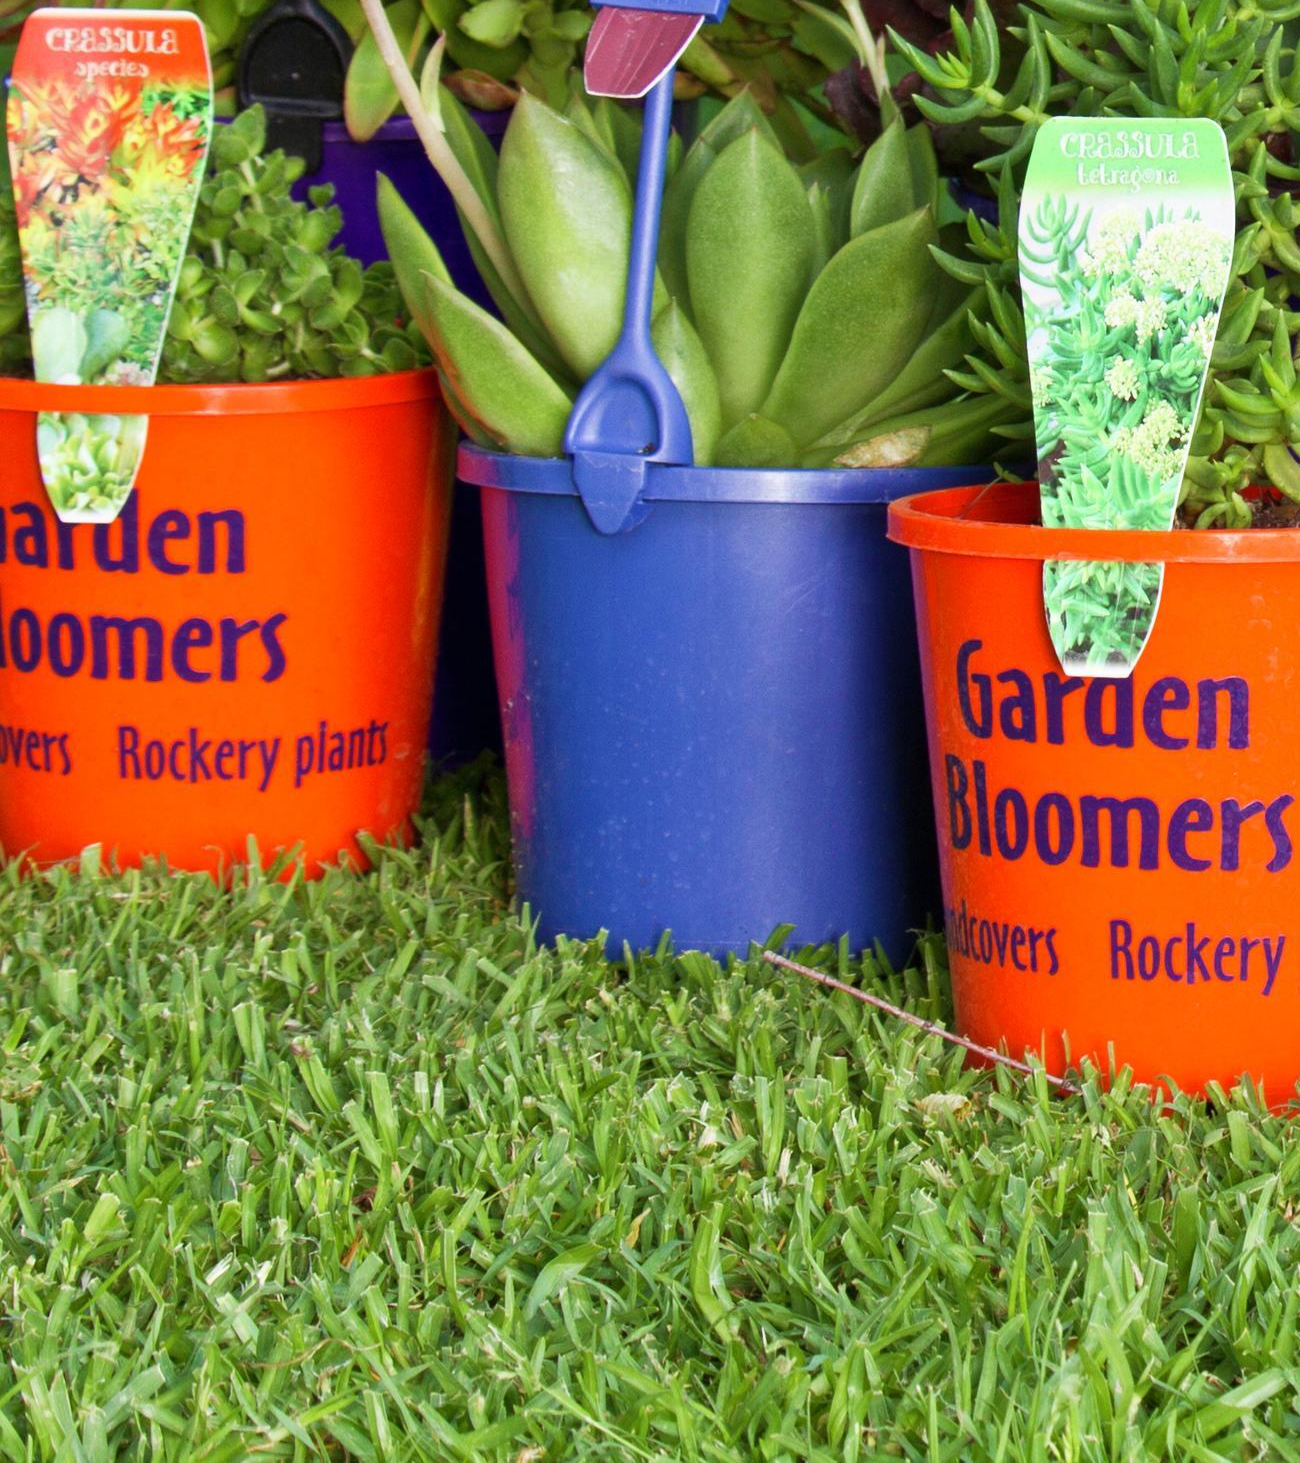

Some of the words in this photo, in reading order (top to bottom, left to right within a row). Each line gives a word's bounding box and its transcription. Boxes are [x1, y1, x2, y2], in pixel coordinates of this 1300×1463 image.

[74, 58, 149, 82] species
[955, 638, 1250, 751] Garden
[117, 724, 281, 793] Rockery
[294, 720, 390, 789] plants
[945, 752, 1296, 875] Bloomers
[1108, 919, 1287, 998] Rockery
